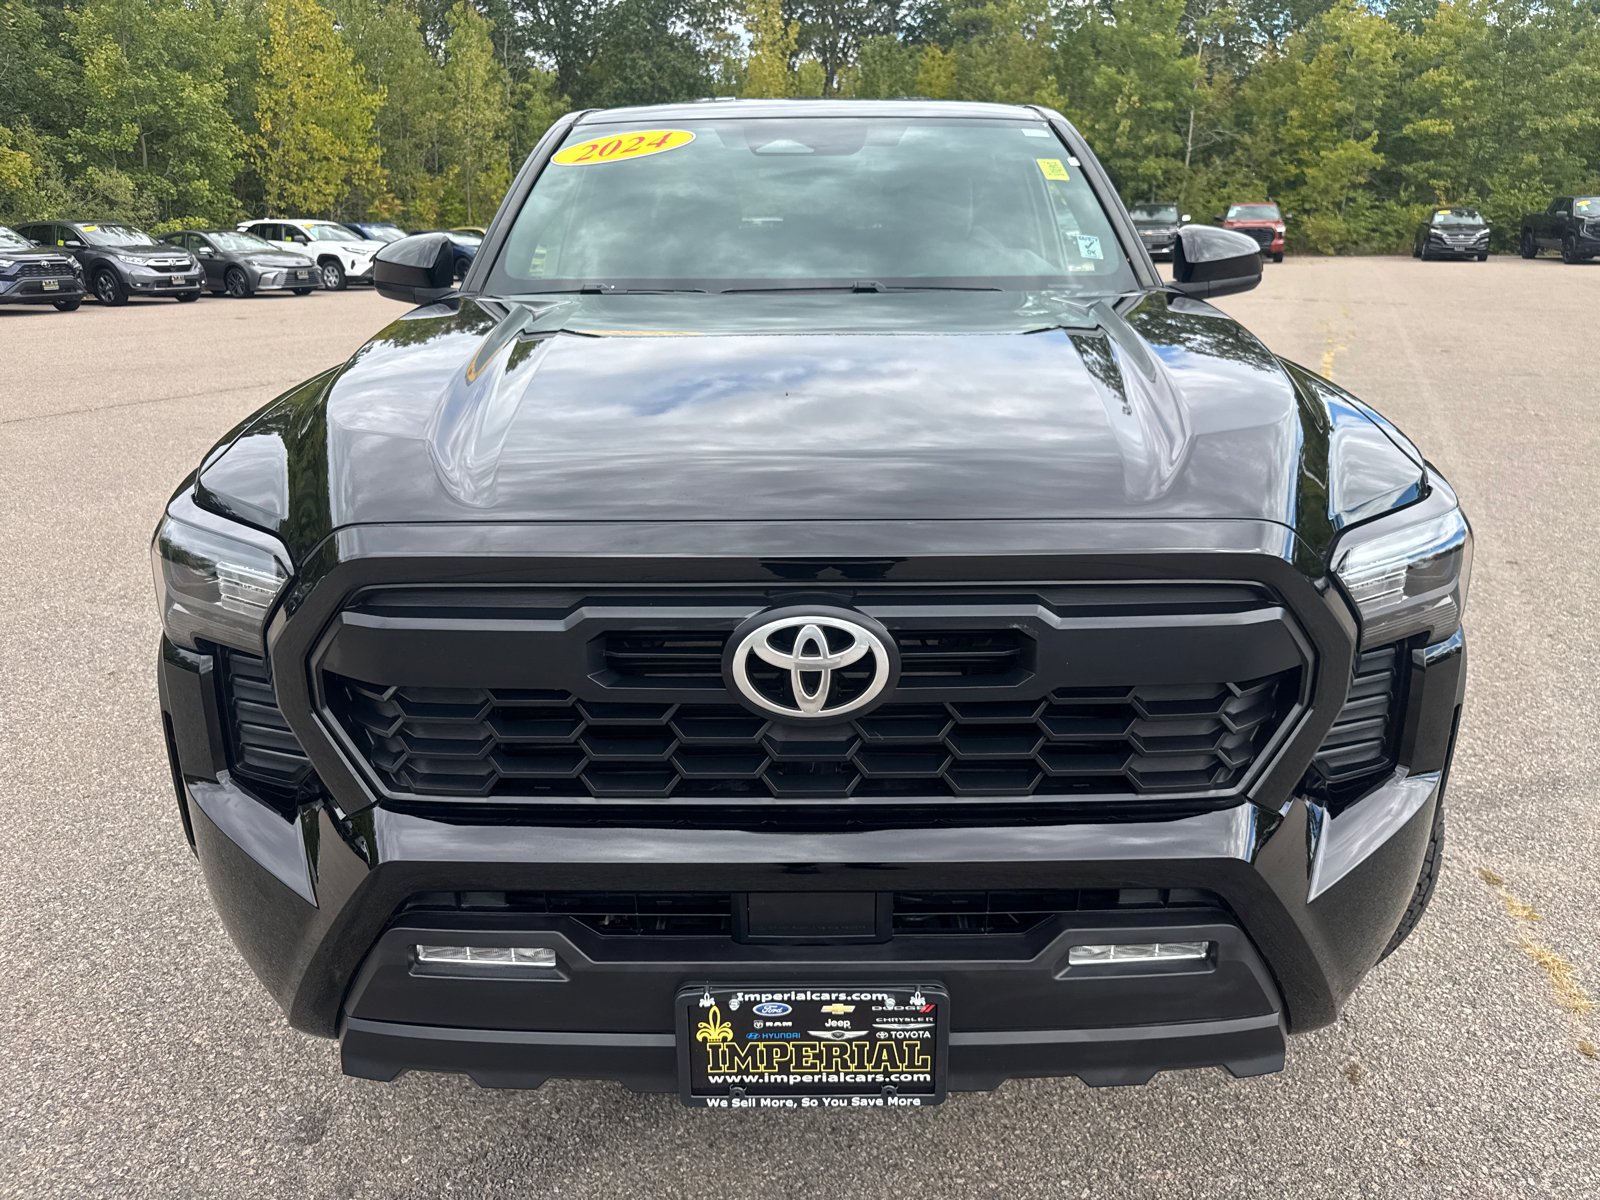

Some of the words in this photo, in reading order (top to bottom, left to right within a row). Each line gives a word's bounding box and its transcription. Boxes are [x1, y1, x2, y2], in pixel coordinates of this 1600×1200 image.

[574, 132, 673, 162] 2024
[737, 992, 888, 1002] Imperialcars.com
[761, 1005, 783, 1013] Ford
[825, 1019, 850, 1028] Jeep
[707, 1041, 931, 1073] IMPERIAL
[708, 1073, 931, 1084] www.imperialcars.com
[707, 1098, 728, 1107] We
[732, 1098, 755, 1107] Sell
[760, 1098, 798, 1108] More,
[802, 1098, 818, 1107] So
[822, 1098, 848, 1107] You
[852, 1098, 883, 1106] Save
[887, 1097, 921, 1106] More
